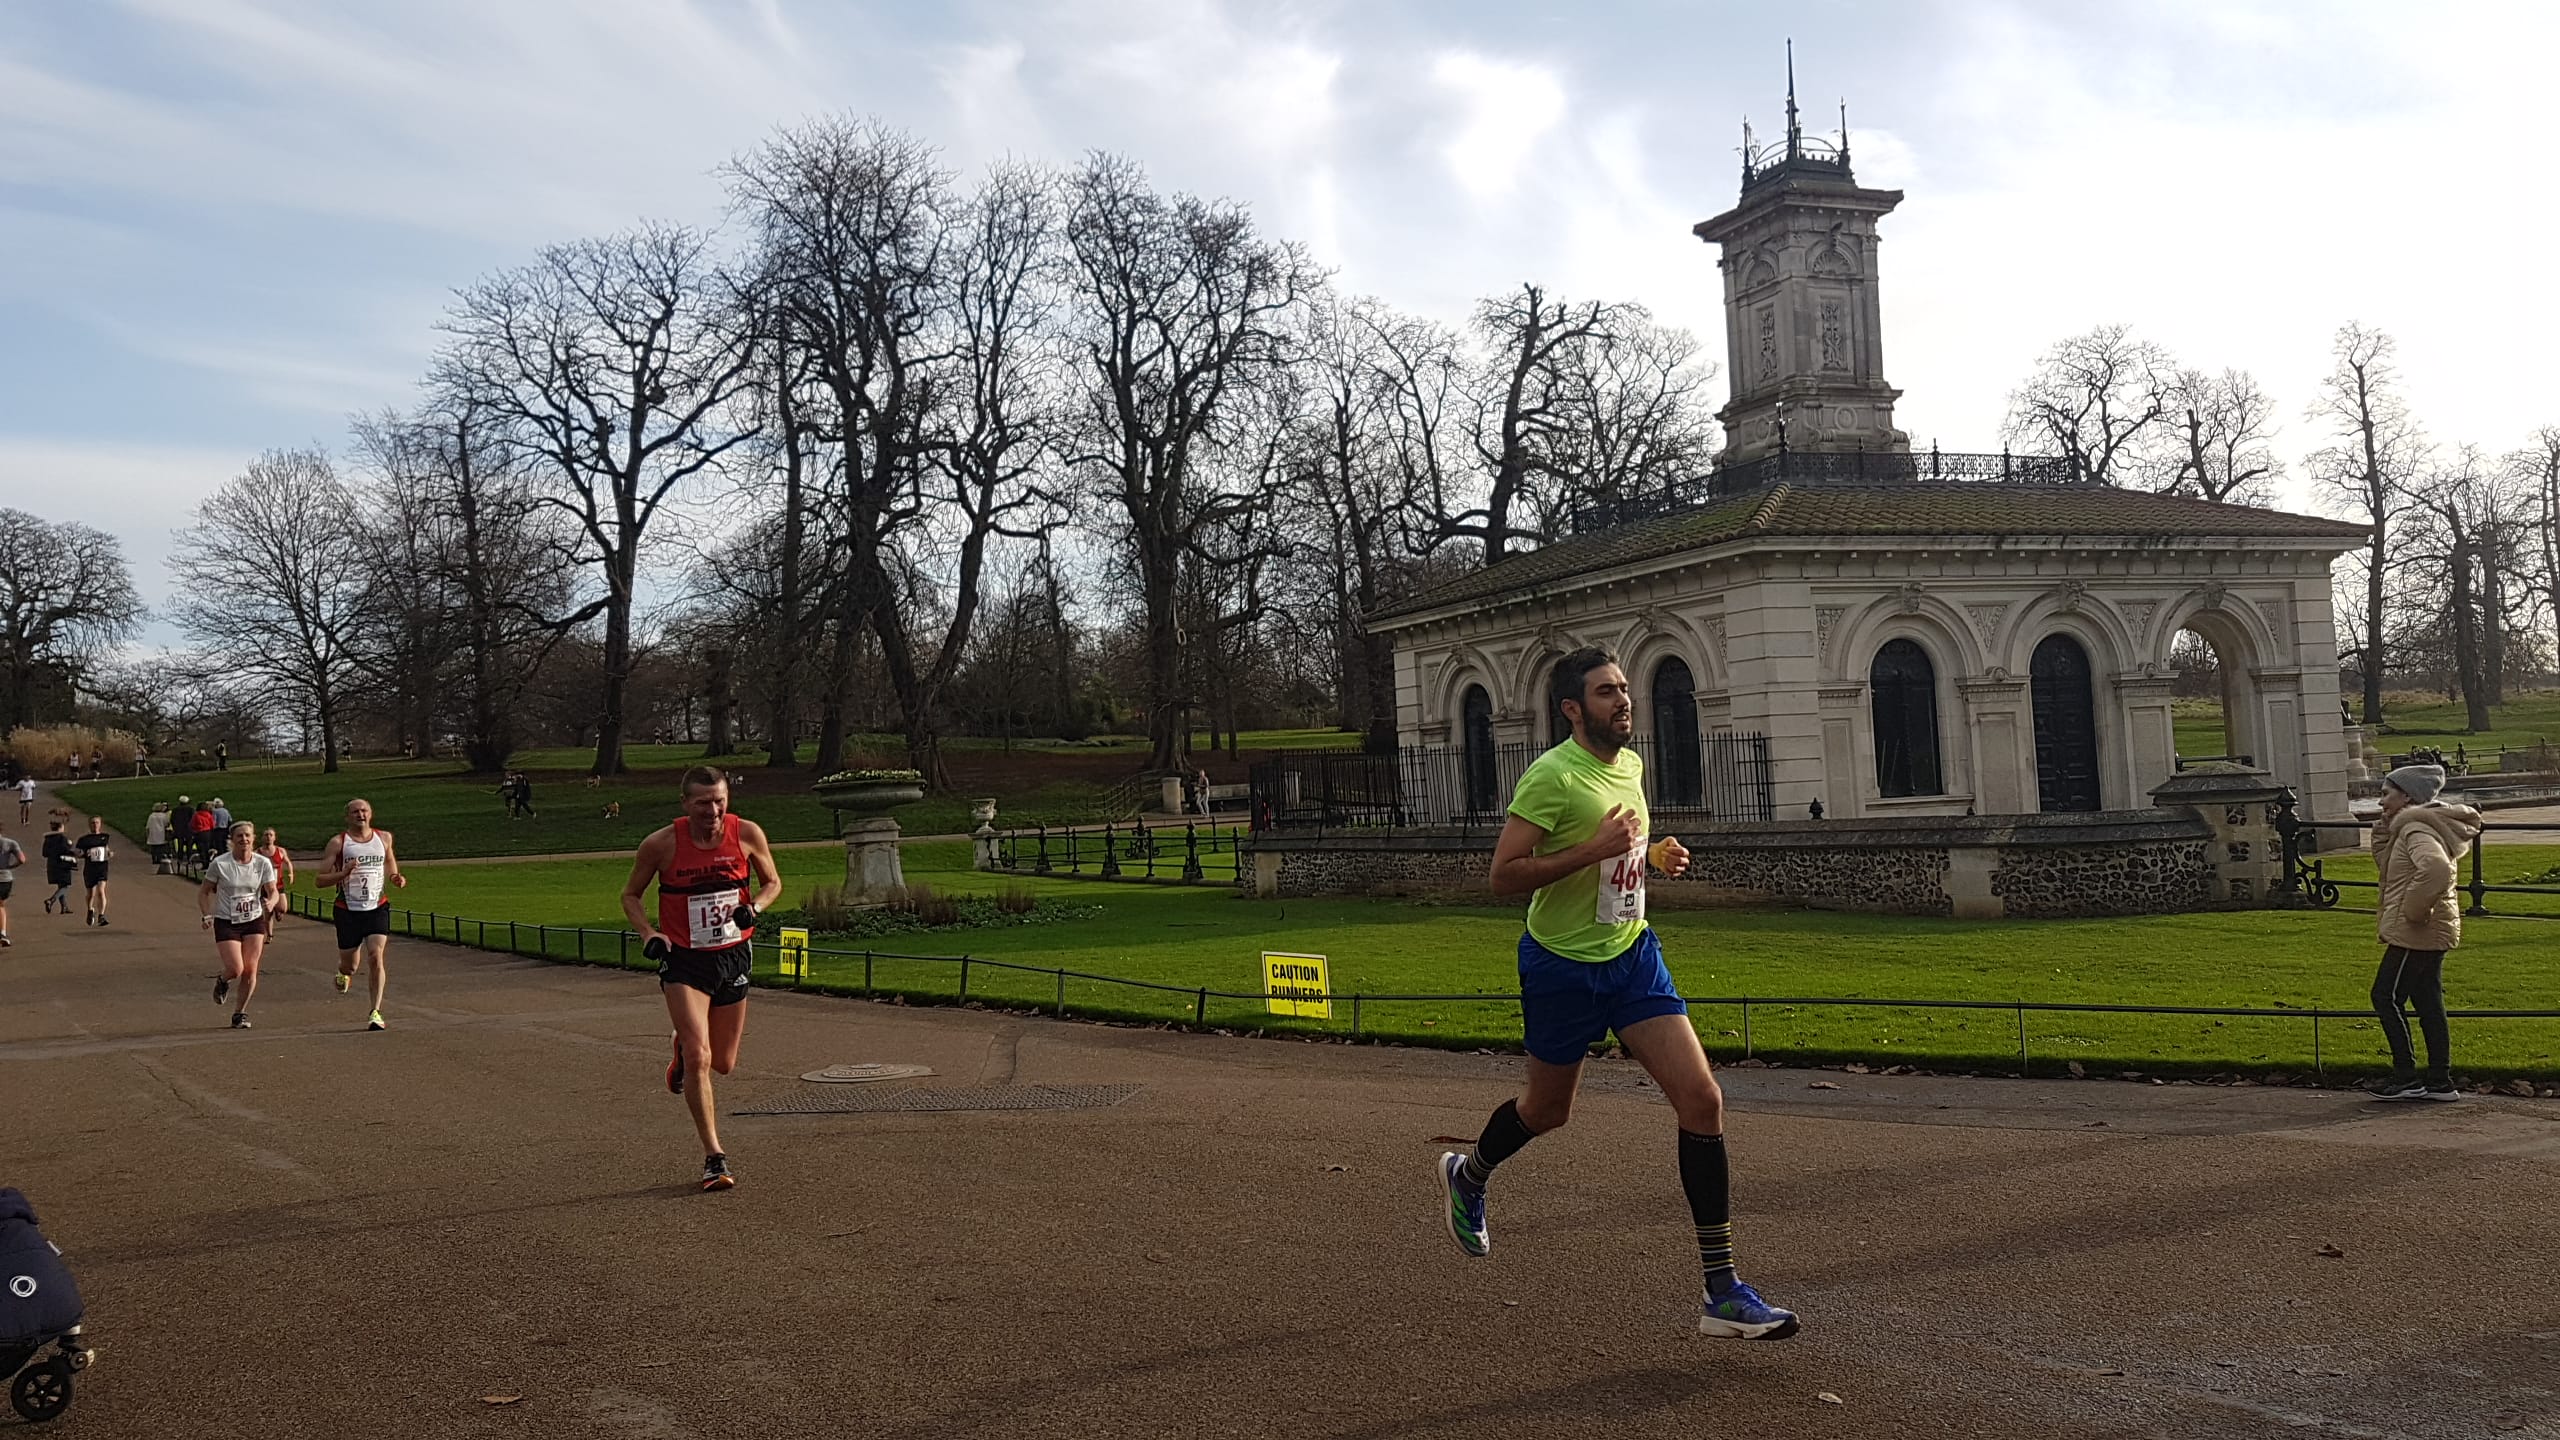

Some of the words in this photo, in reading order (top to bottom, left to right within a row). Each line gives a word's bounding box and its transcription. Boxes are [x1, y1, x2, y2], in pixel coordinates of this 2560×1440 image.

[361, 877, 368, 889] 2
[701, 904, 733, 928] 132
[1272, 964, 1319, 981] CAUTION
[1271, 985, 1324, 1004] RUNNERS
